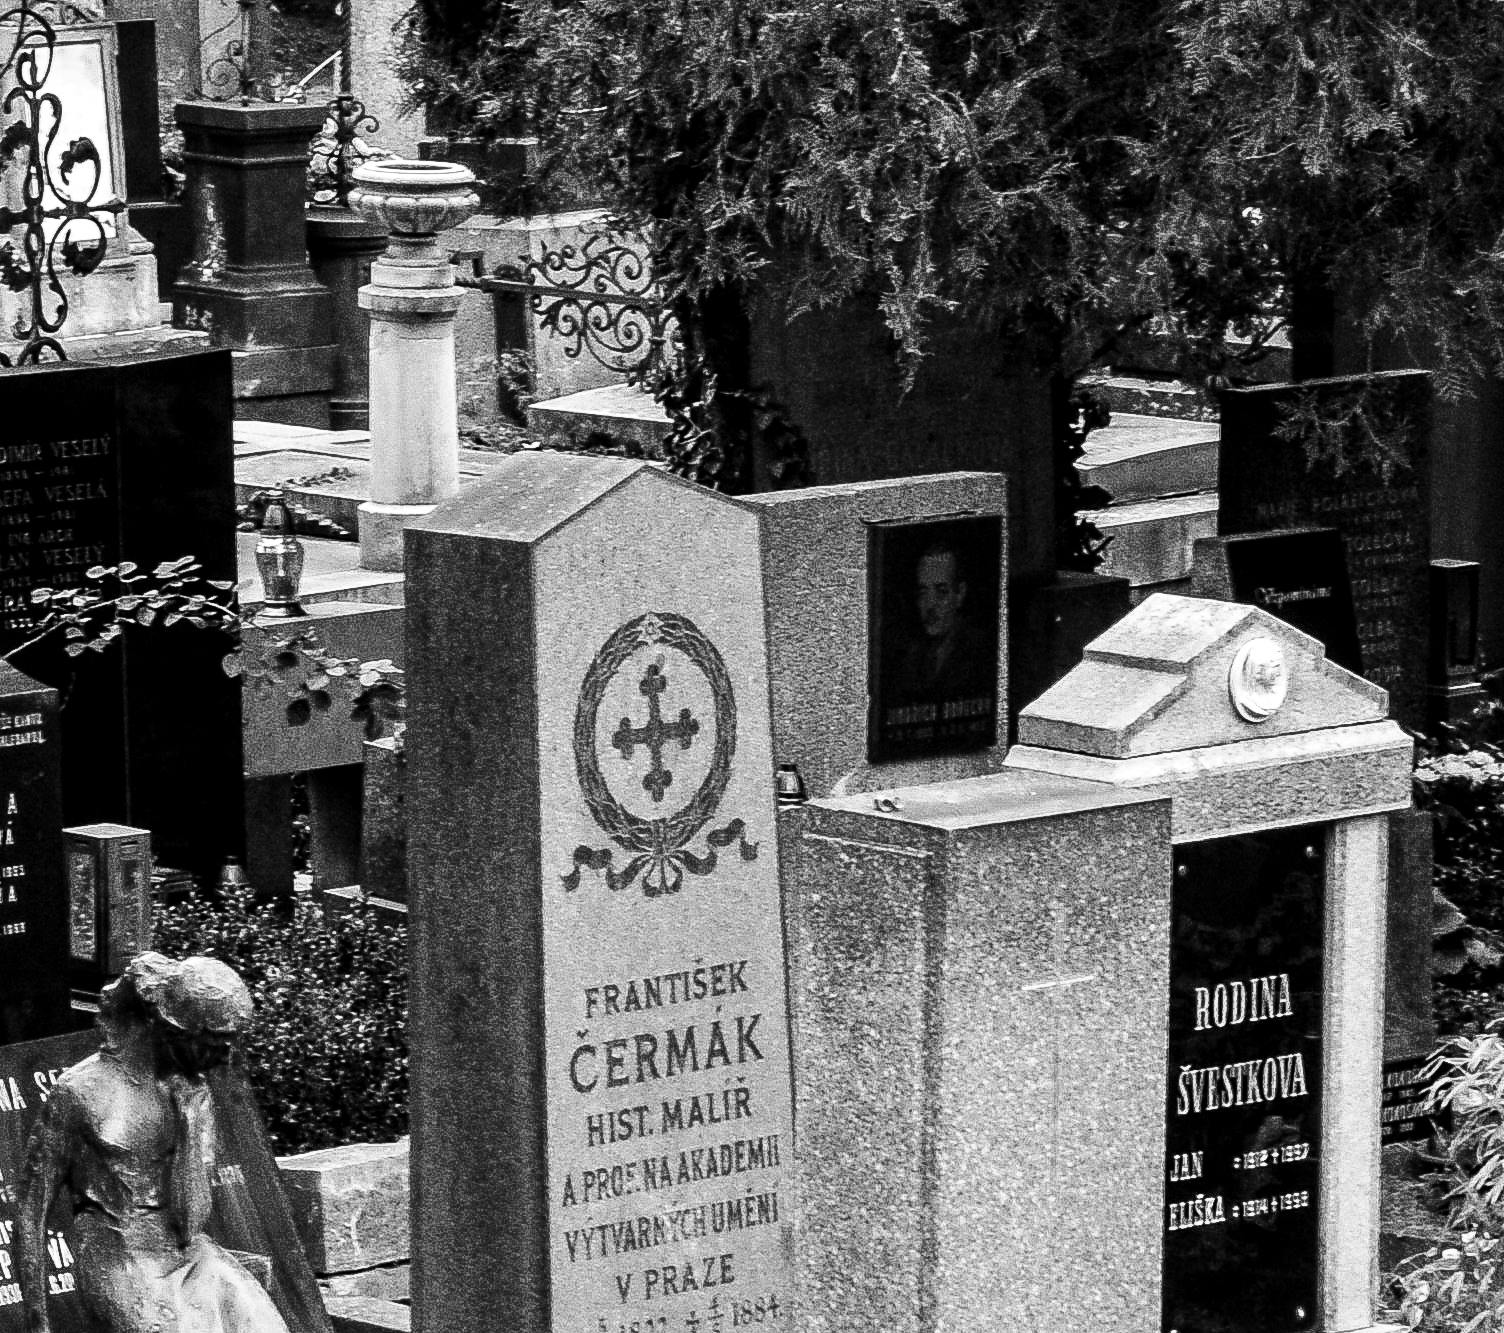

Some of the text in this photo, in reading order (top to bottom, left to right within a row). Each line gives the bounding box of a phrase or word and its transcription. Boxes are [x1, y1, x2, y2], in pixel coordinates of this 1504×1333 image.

[583, 958, 750, 1019] FRANTIŠEK
[1194, 973, 1294, 1031] RODINA
[568, 1005, 765, 1095] ČERMÁK
[586, 1077, 753, 1148] HIST. MALÍŘ
[1177, 1053, 1309, 1115] ŠVESTKOVA
[561, 1173, 578, 1207] A
[642, 1156, 674, 1190] NA
[677, 1134, 782, 1185] AKADEMII
[1170, 1151, 1204, 1182] JAN
[1168, 1193, 1226, 1231] ELIŠKA
[616, 1253, 737, 1304] V PRAZE
